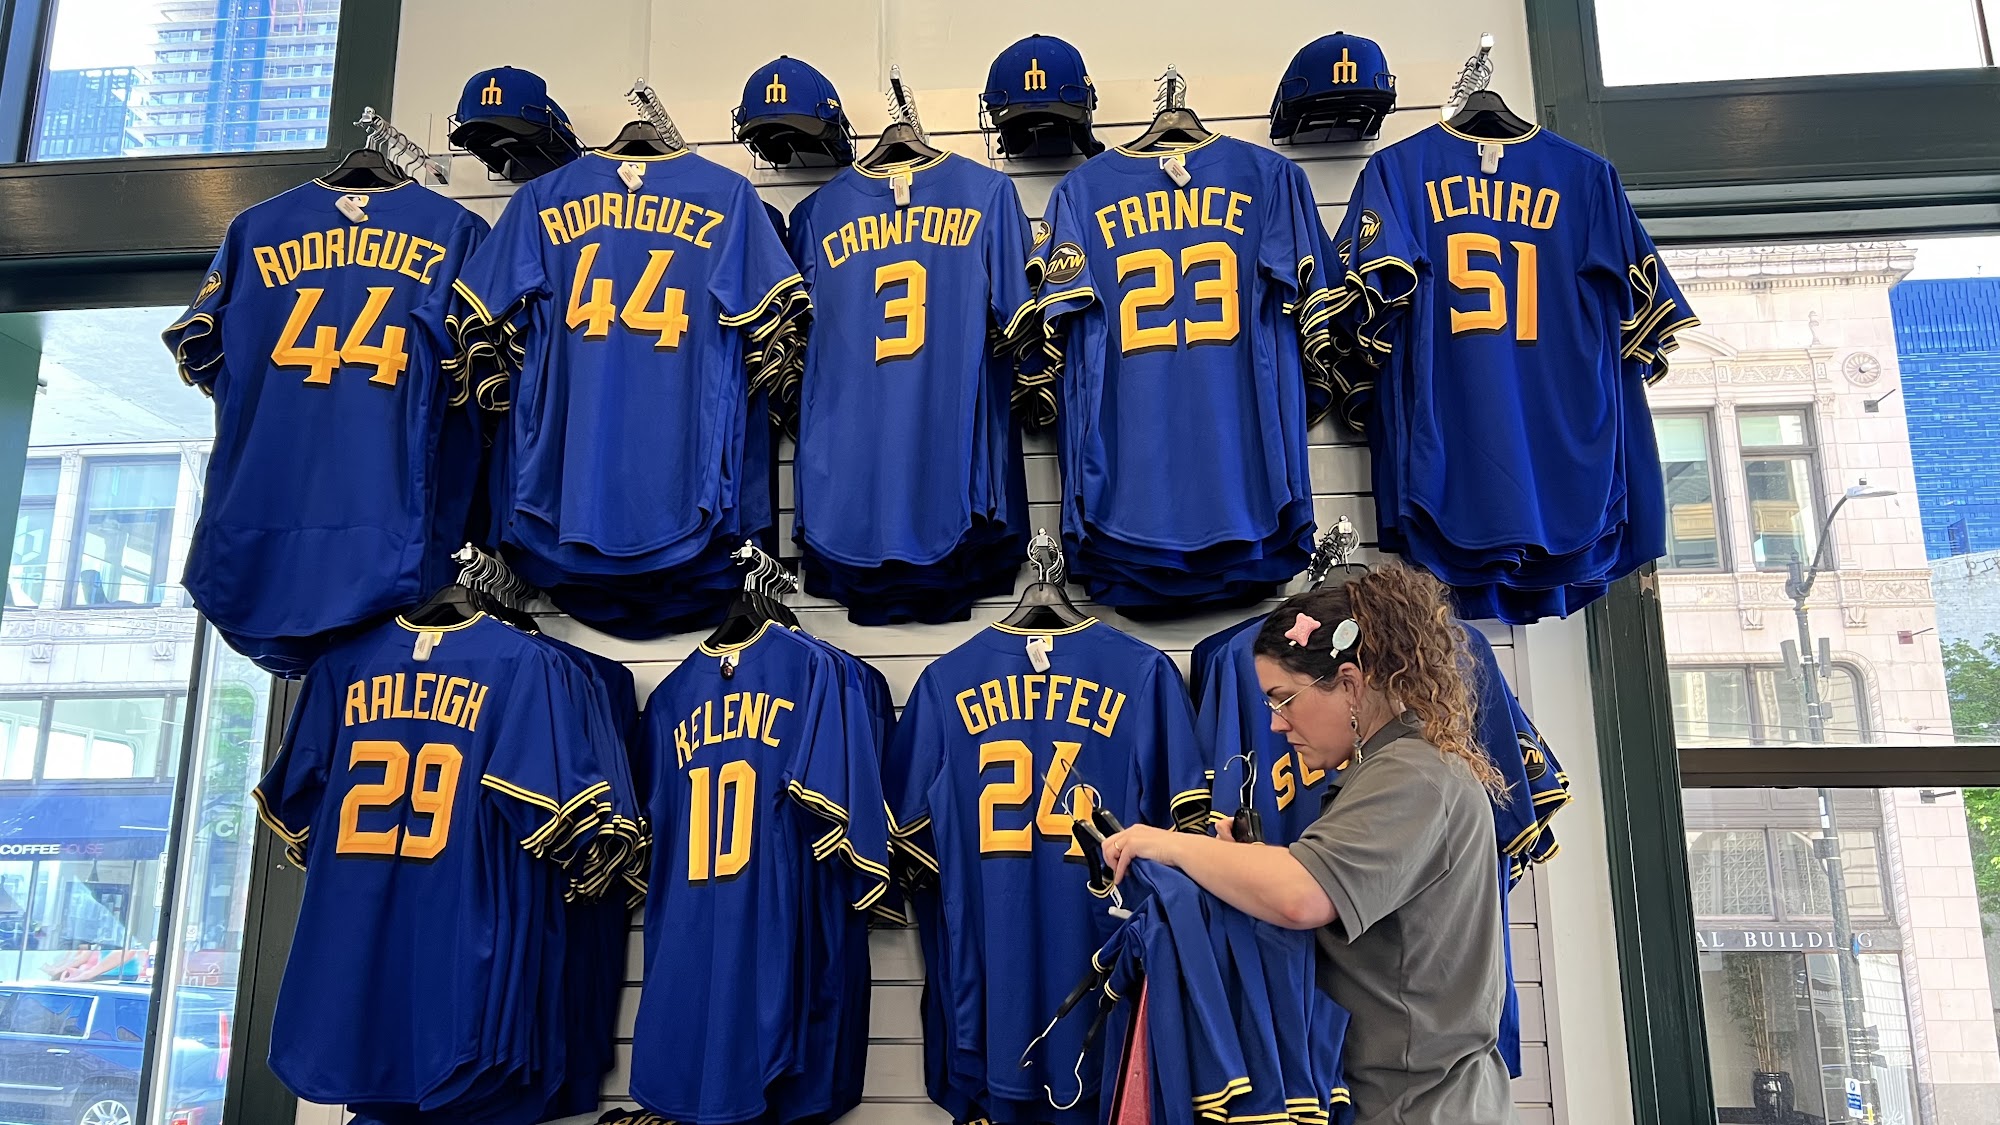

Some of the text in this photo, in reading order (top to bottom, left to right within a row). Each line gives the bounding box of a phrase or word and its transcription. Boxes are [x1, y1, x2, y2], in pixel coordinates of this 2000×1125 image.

[539, 193, 725, 249] RODRIGUEZ
[1096, 187, 1253, 250] FRANCE
[1426, 176, 1561, 230] ICHIRO
[253, 225, 447, 288] RODRIGUEZ
[822, 206, 982, 269] CRAWFORD
[565, 243, 691, 349] 44
[875, 261, 928, 362] 3
[1116, 242, 1241, 356] 23
[1446, 233, 1539, 343] 51
[270, 287, 409, 387] 44
[344, 672, 489, 732] RALEIGH
[955, 675, 1126, 739] GRIFFEY
[335, 740, 464, 860] 29
[688, 759, 757, 882] 10
[978, 740, 1096, 858] 24
[0, 843, 60, 855] COFFEE
[1744, 931, 1873, 948] BUILDIG
